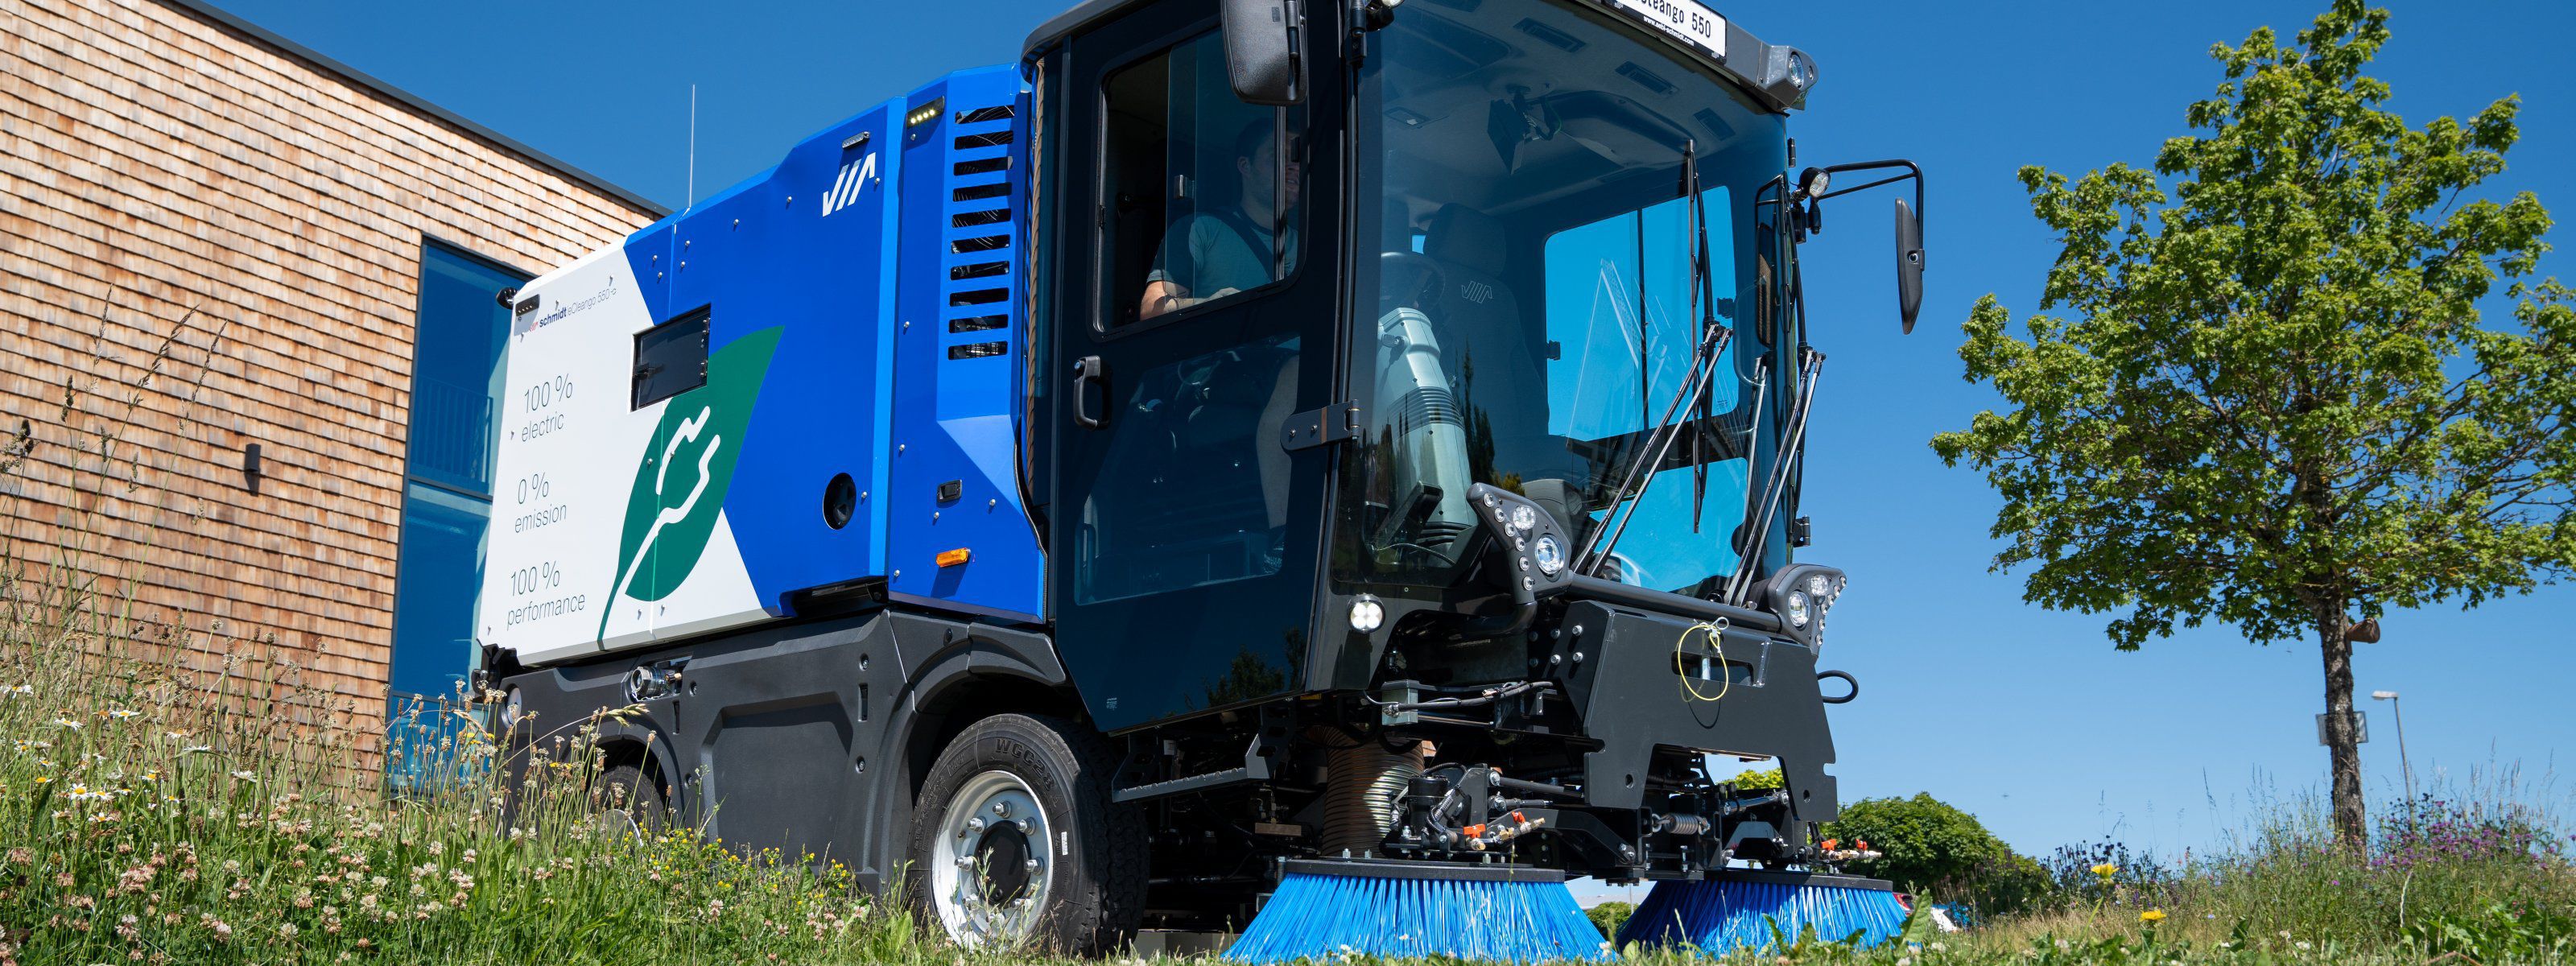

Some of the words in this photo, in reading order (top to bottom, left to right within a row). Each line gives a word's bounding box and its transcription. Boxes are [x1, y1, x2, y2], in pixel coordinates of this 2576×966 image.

[1643, 16, 1695, 46] www.aebi-schmidt.com
[1691, 12, 1711, 38] 550
[539, 308, 567, 328] schmidt
[568, 296, 596, 316] eCleango
[524, 382, 550, 414] 100
[555, 374, 572, 402] %
[522, 411, 564, 442] electric
[518, 479, 526, 504] 0
[532, 472, 549, 500] %
[514, 503, 567, 533] emission
[511, 567, 537, 596] 100
[543, 560, 560, 589] %
[507, 595, 584, 631] performance
